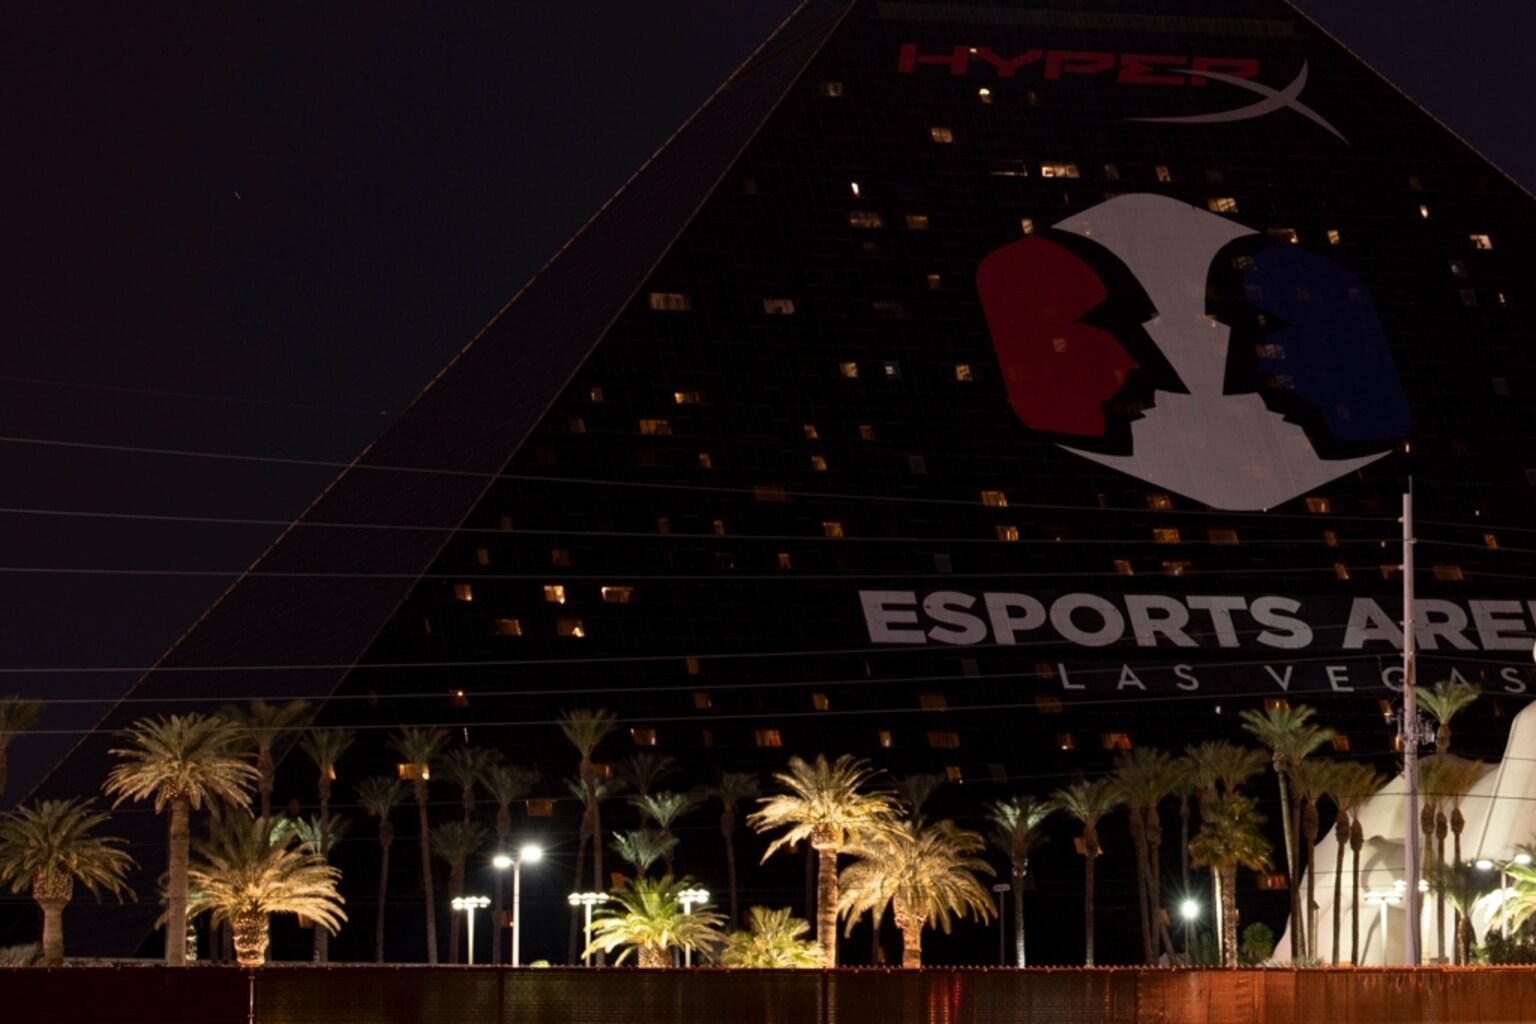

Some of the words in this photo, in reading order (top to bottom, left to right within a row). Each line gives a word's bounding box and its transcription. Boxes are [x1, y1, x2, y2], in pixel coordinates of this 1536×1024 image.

[858, 589, 1314, 650] ESPORTS
[1057, 662, 1200, 692] LAS
[1264, 665, 1528, 694] VEGAS
